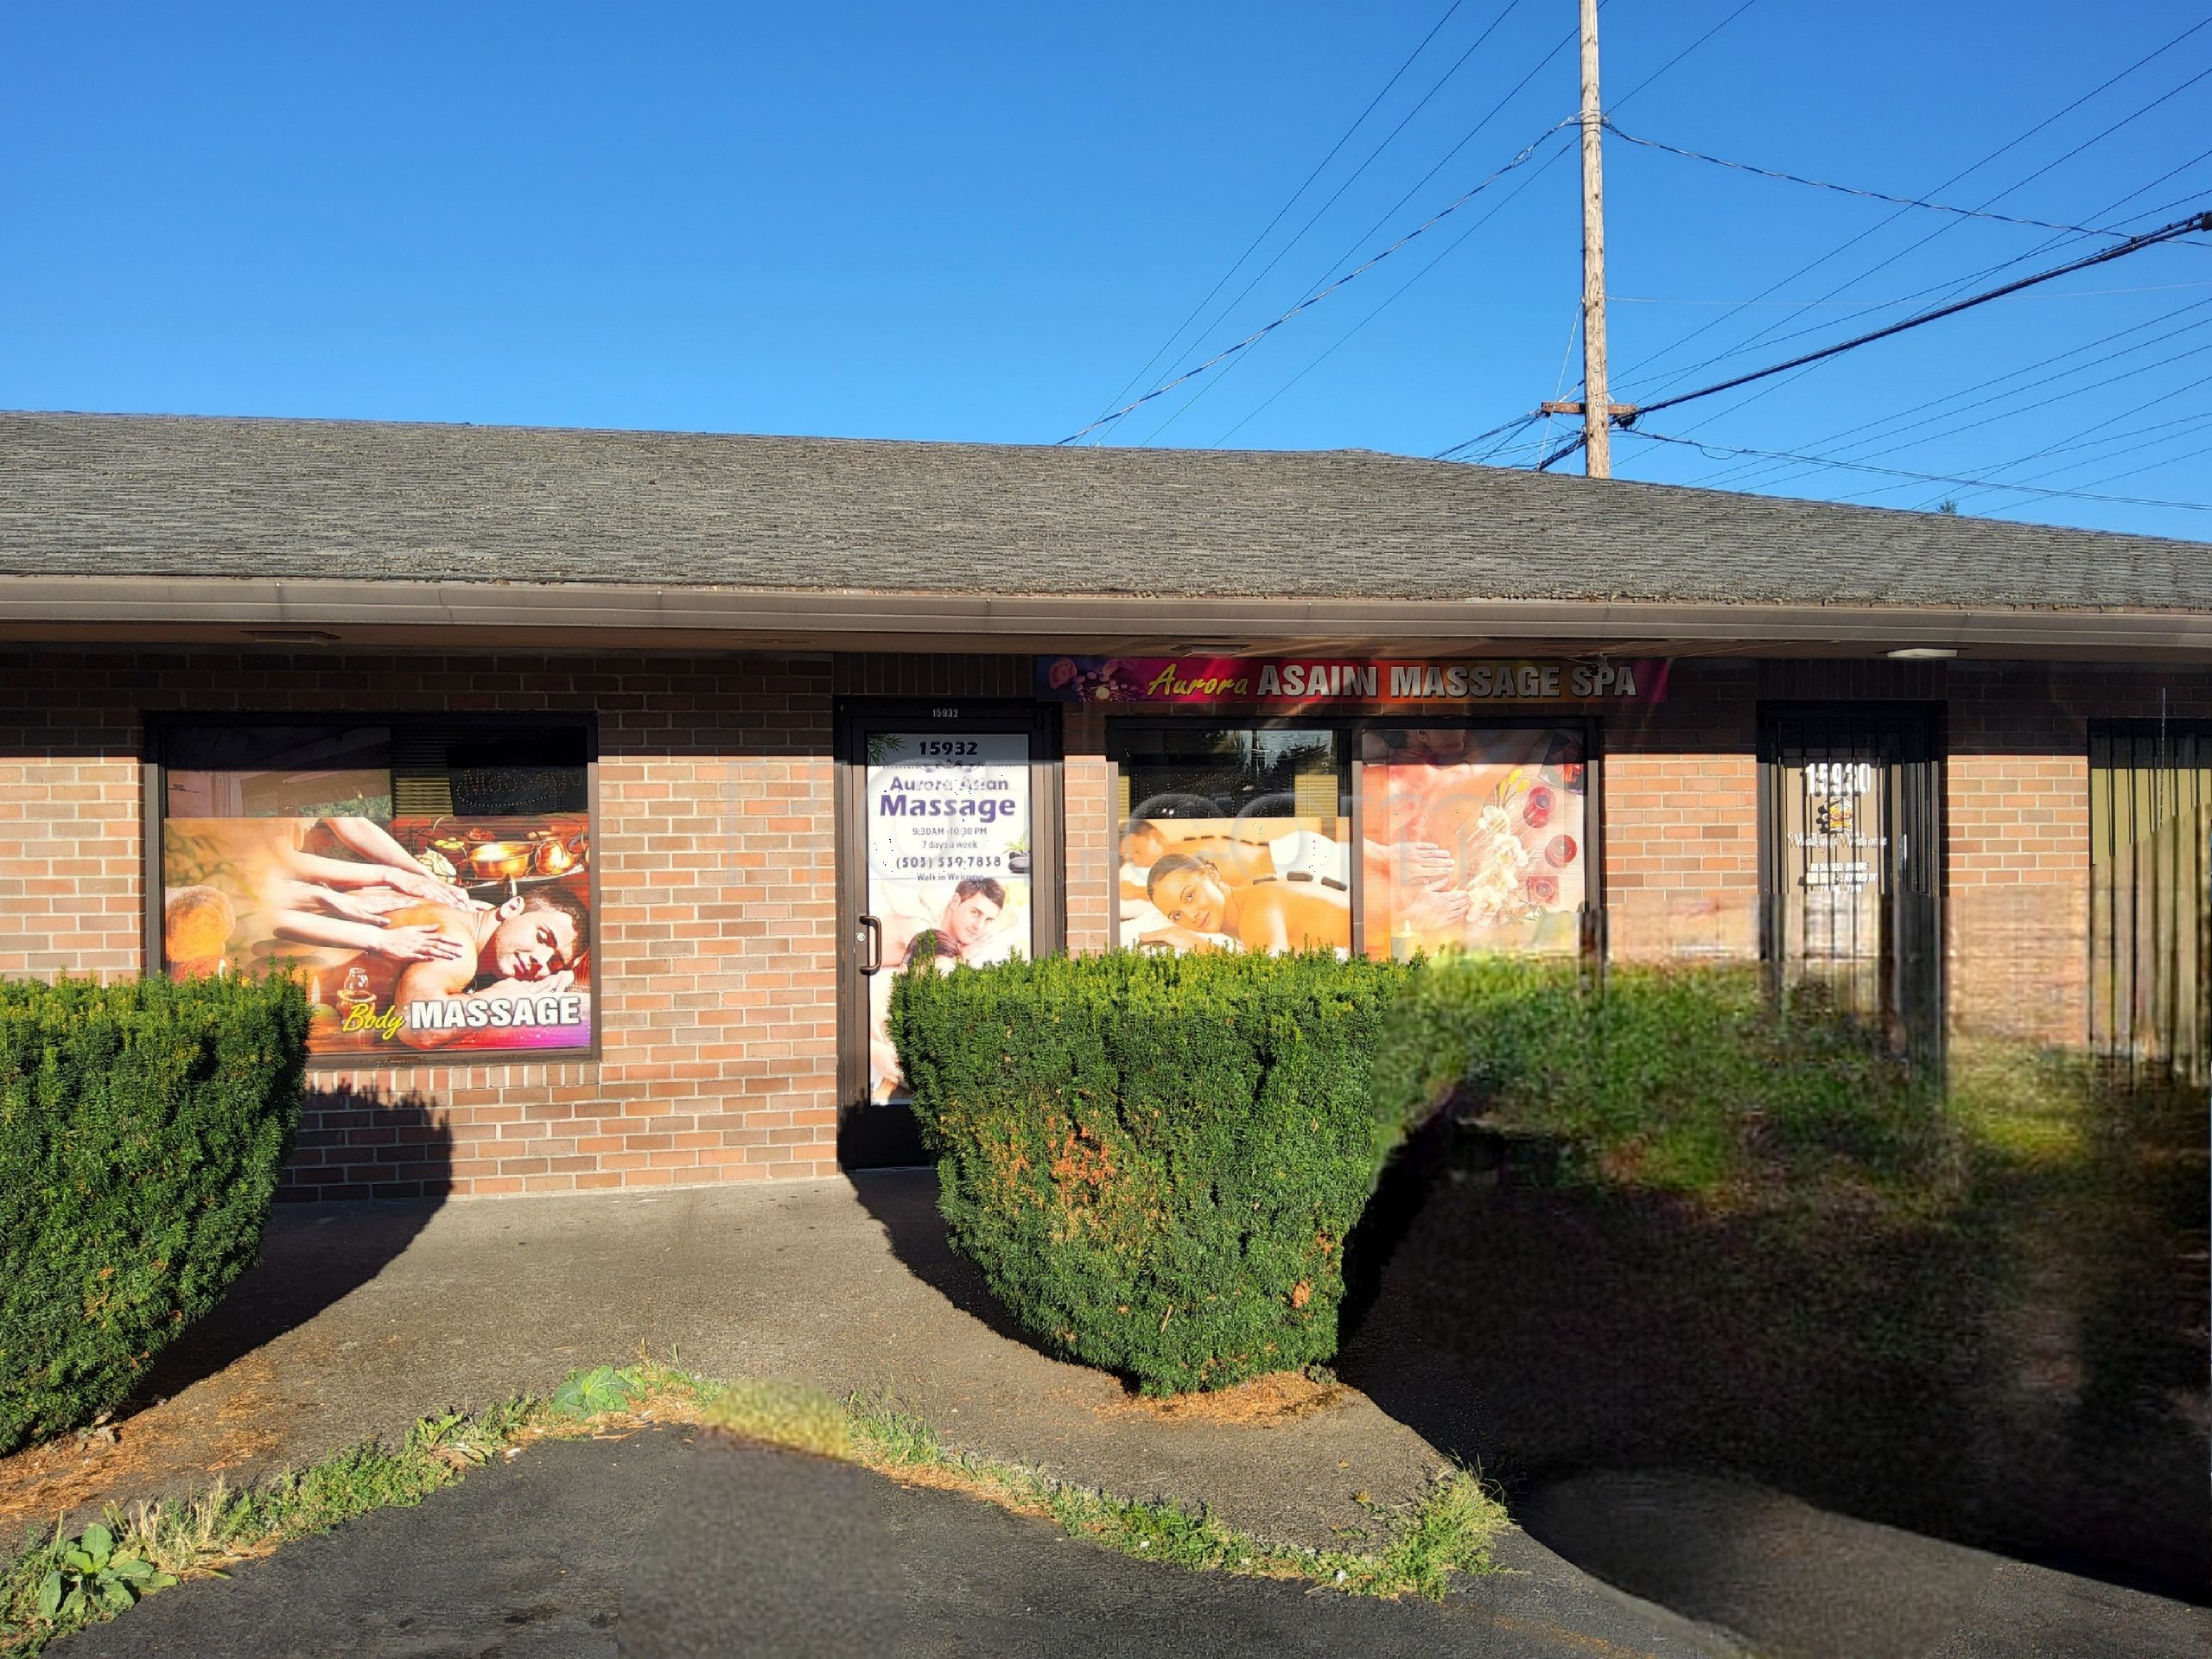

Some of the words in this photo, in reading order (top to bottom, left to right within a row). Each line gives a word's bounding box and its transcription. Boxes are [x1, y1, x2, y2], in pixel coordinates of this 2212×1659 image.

[1147, 663, 1249, 696] Aurora
[1390, 666, 1560, 697] MASSAGE
[1572, 666, 1637, 696] SPA
[932, 708, 958, 718] 15932
[918, 741, 978, 755] 15932
[880, 794, 1016, 823] Massage
[341, 1003, 405, 1039] Body
[410, 996, 582, 1029] MASSAGE
